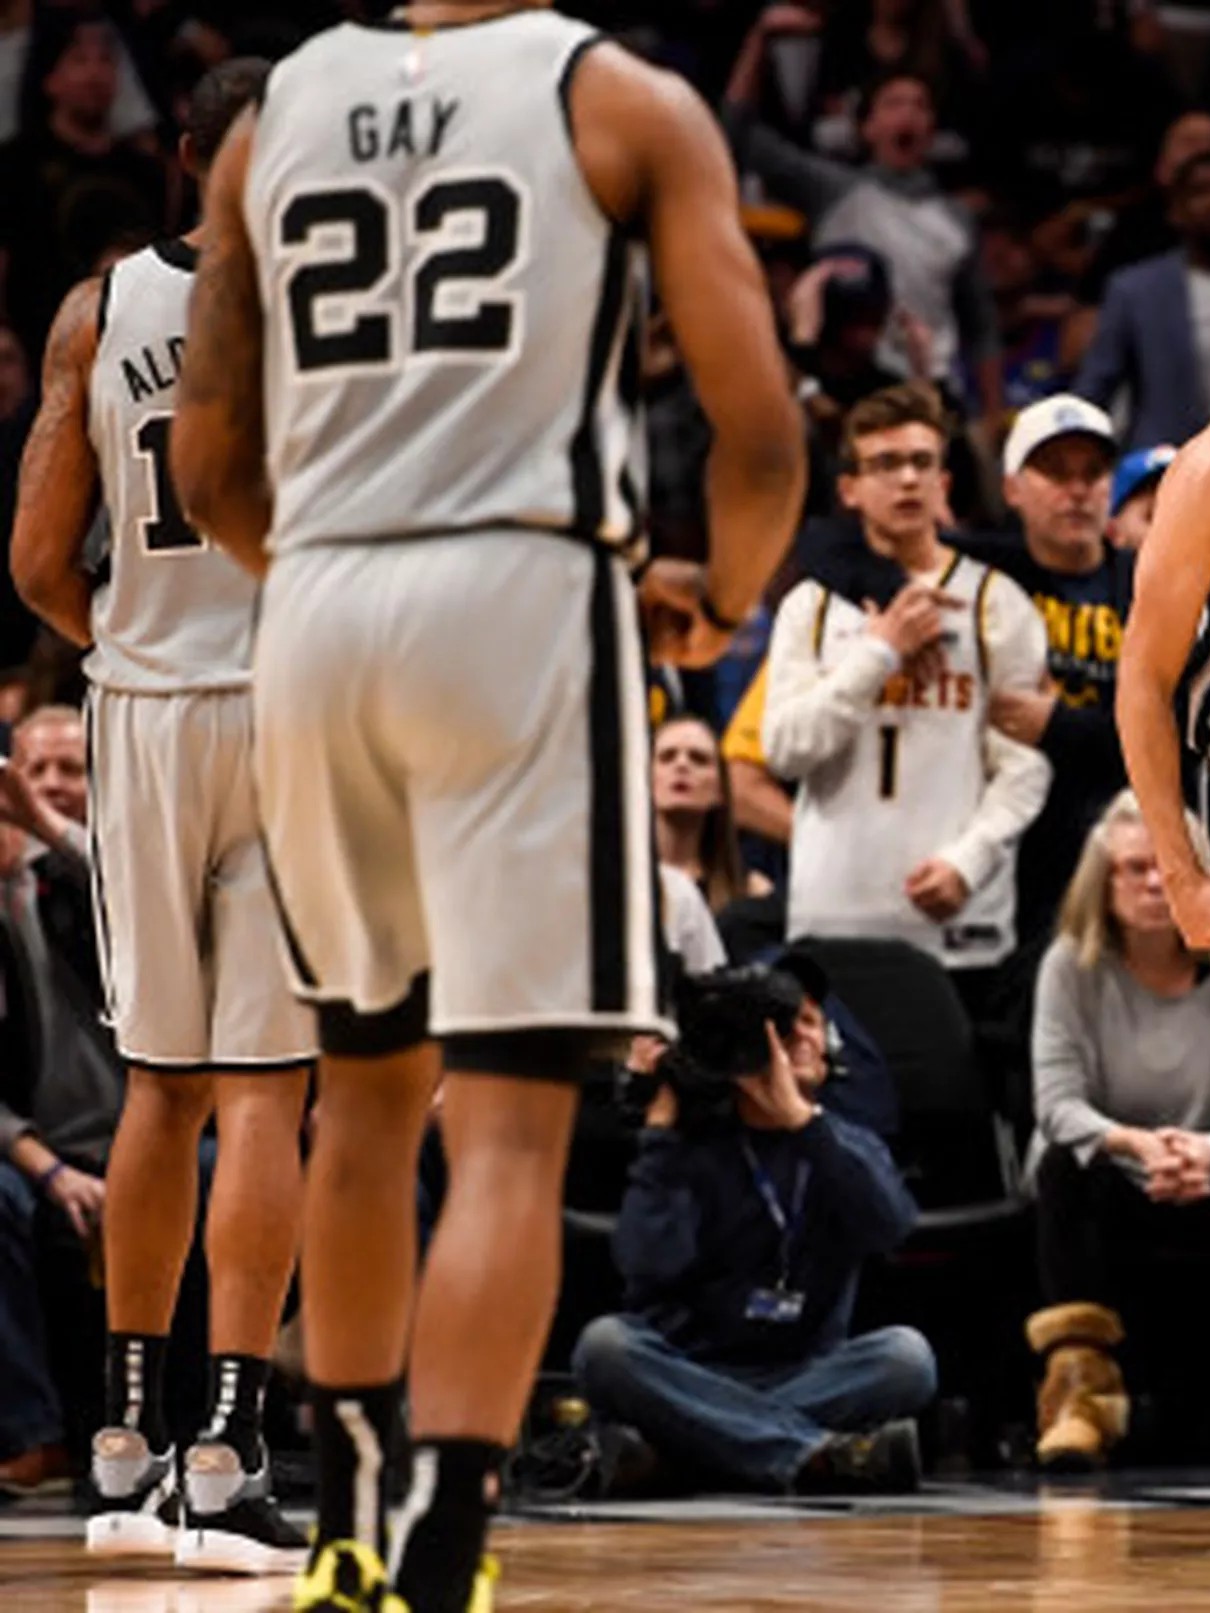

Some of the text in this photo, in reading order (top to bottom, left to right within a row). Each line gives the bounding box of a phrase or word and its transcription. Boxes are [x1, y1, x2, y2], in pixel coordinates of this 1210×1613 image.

[348, 97, 460, 164] GAY
[278, 175, 523, 374] 22
[879, 724, 898, 800] 1
